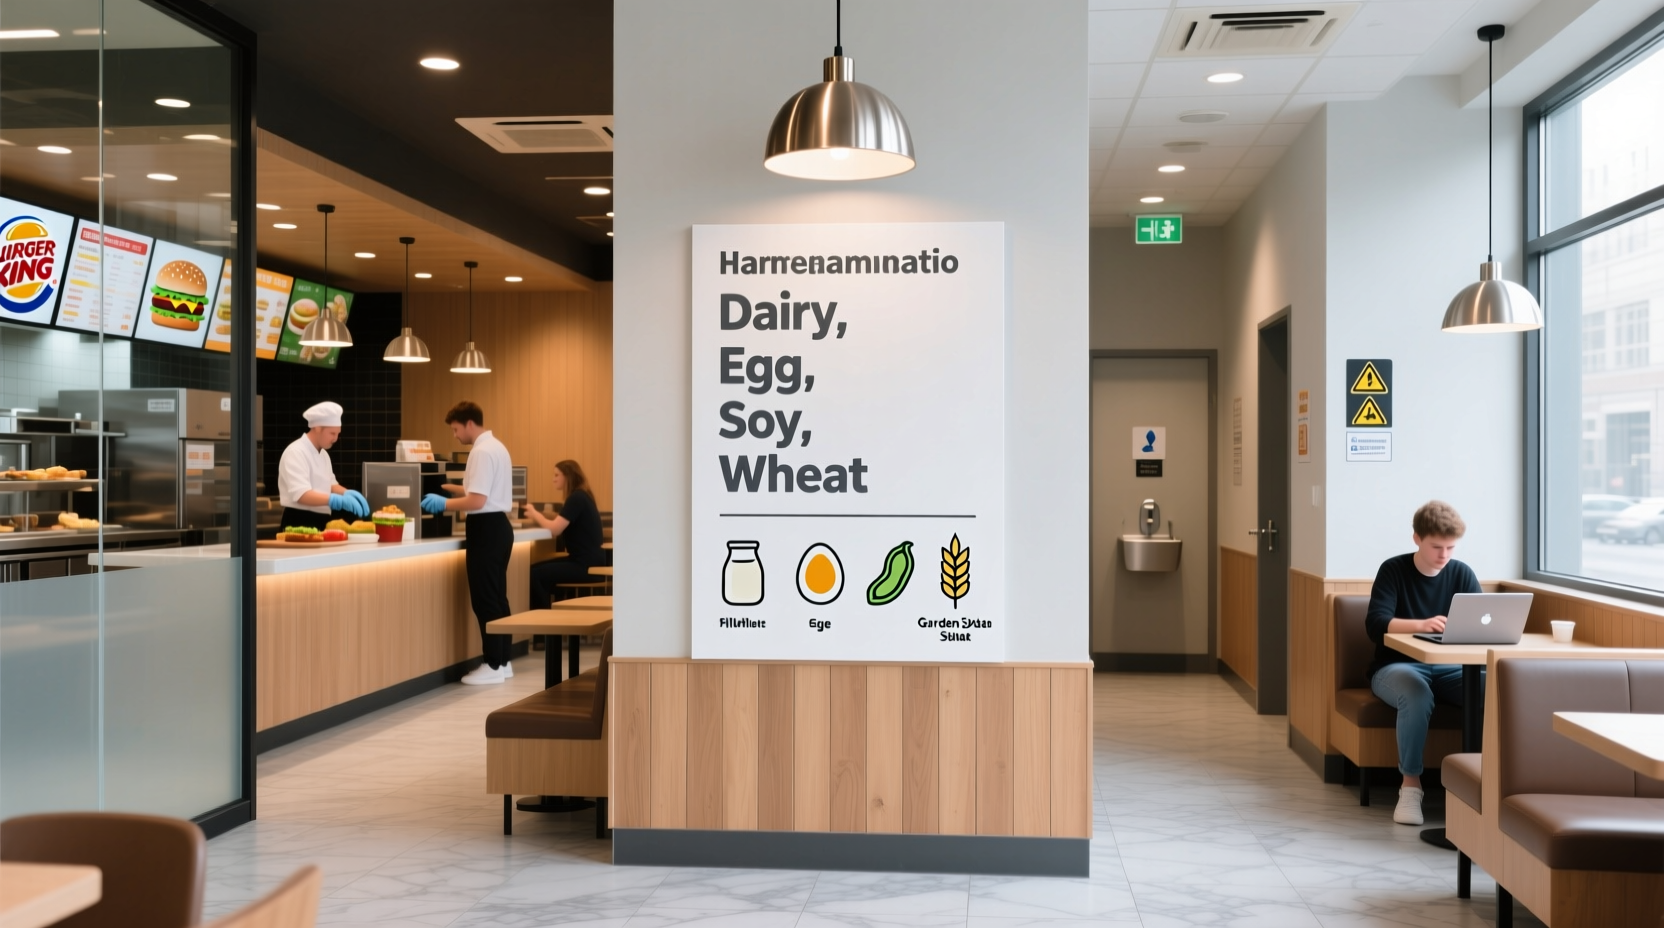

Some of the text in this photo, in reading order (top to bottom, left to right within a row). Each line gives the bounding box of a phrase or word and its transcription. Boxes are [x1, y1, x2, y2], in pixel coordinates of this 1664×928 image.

[0, 257, 54, 287] KING
[720, 289, 848, 341] Dairy,
[720, 346, 815, 395] Egg,
[718, 400, 812, 449] Soy,
[718, 453, 869, 494] Wheat
